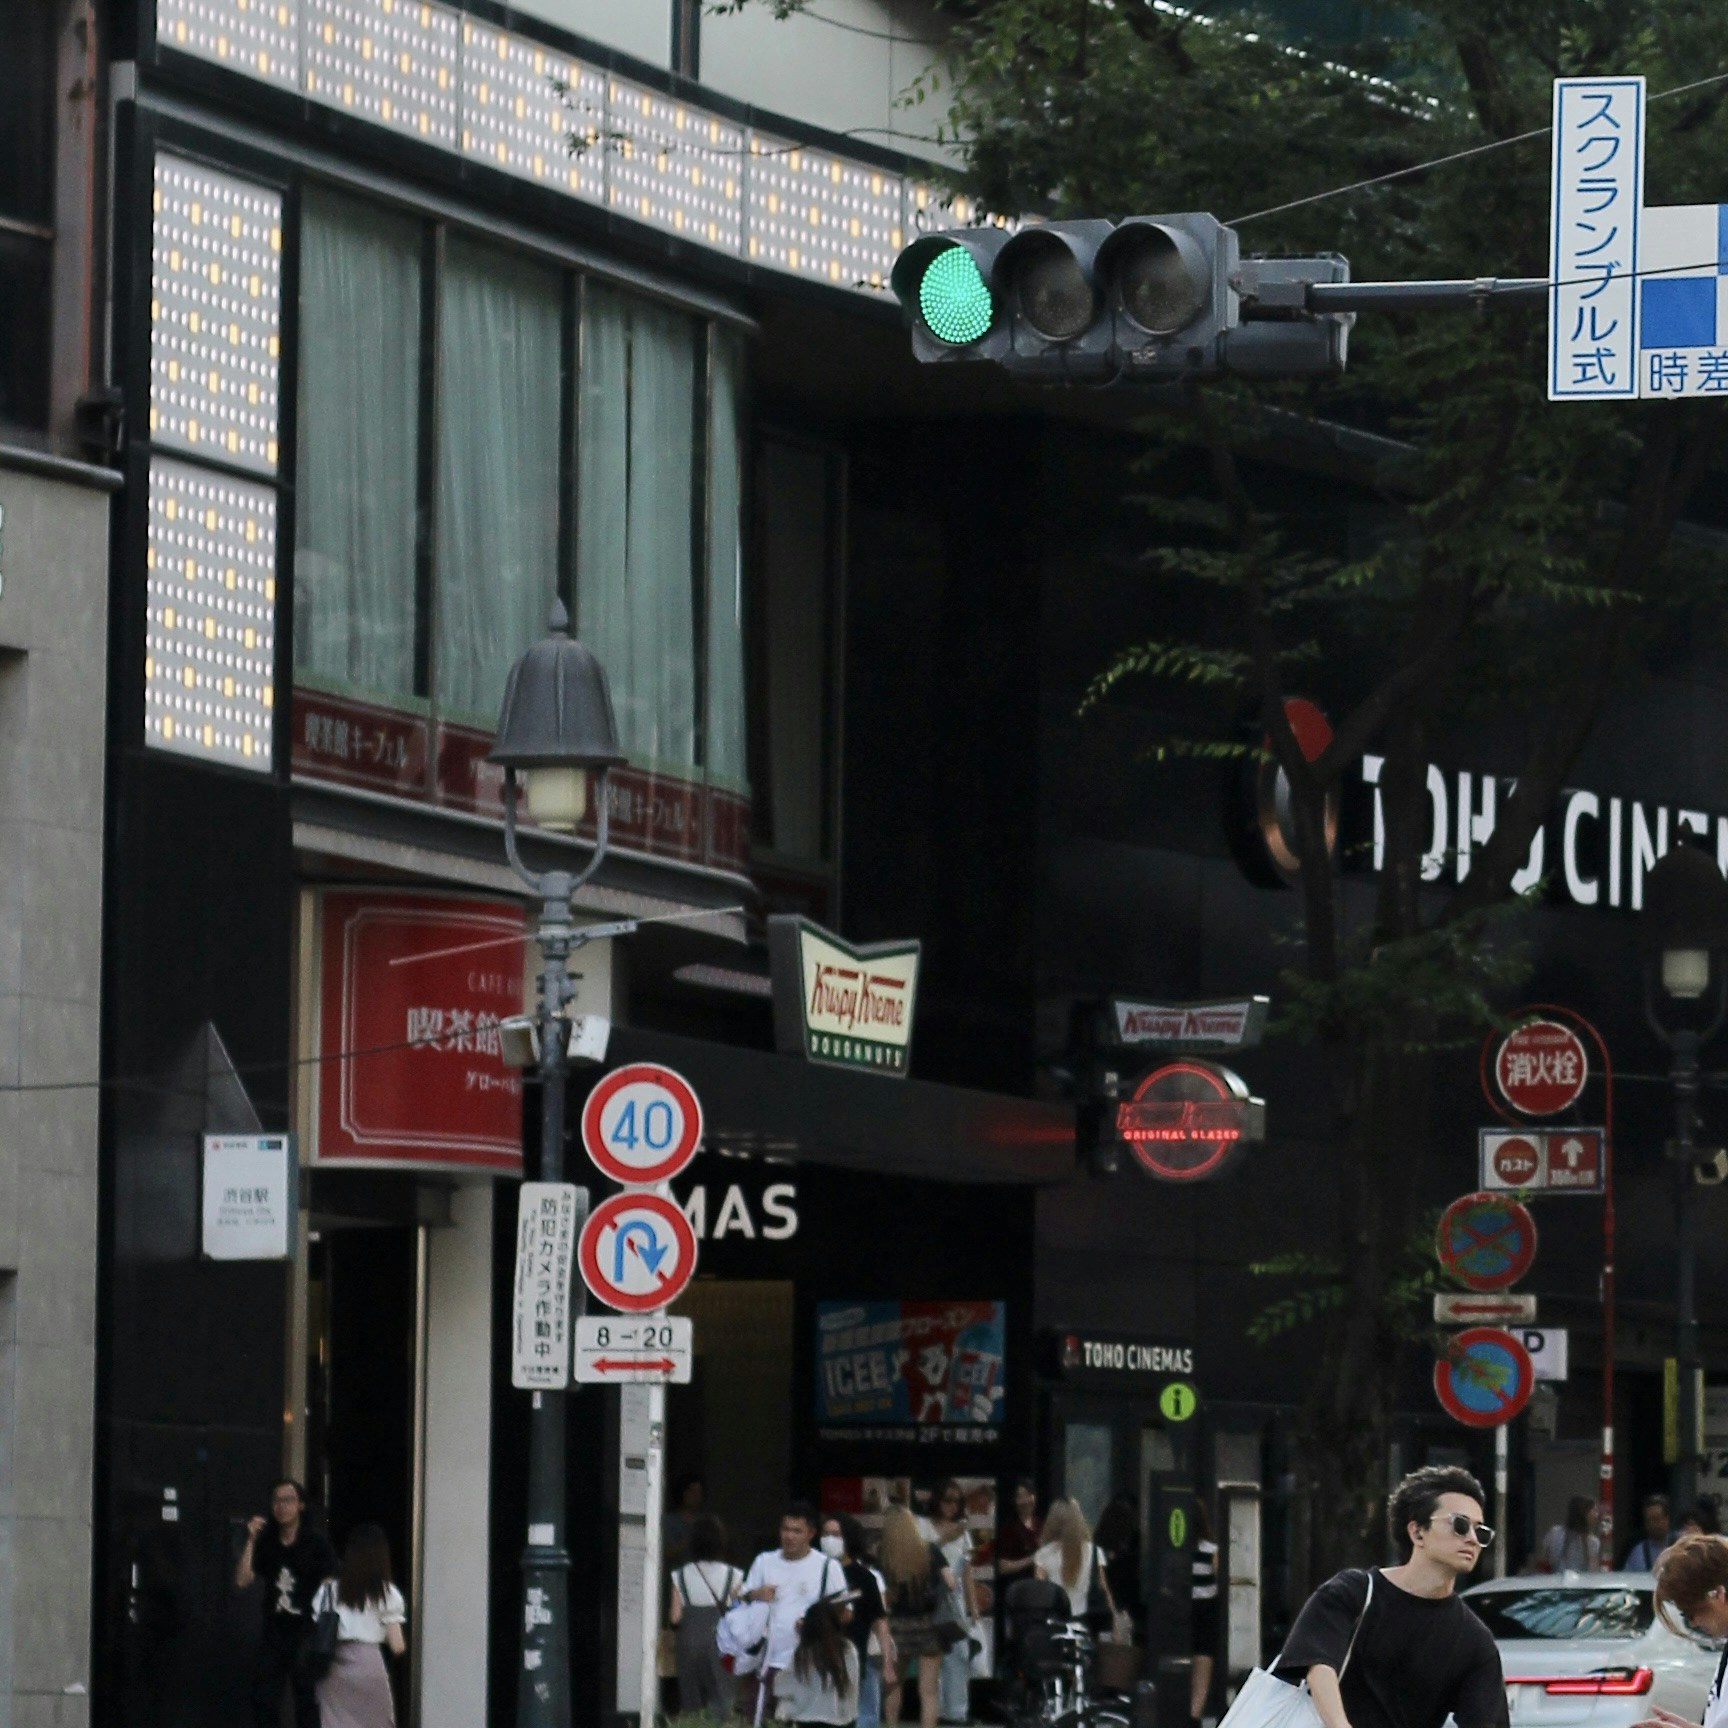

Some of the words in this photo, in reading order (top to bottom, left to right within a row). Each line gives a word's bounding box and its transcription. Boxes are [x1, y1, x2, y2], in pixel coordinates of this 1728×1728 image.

[1571, 93, 1622, 386] スクランブル式
[810, 962, 859, 1030] Krispy
[858, 972, 906, 1026] Kreme
[810, 1035, 902, 1068] DOUGHNUTS
[1506, 1051, 1579, 1088] 消火栓
[611, 1099, 674, 1151] 40
[1122, 1128, 1187, 1142] ORIGINAL
[1190, 1128, 1241, 1142] GLAZED
[534, 1198, 557, 1358] 防犯カメラ作動中
[1084, 1341, 1125, 1368] TOHO
[1127, 1345, 1193, 1374] CINEMAS
